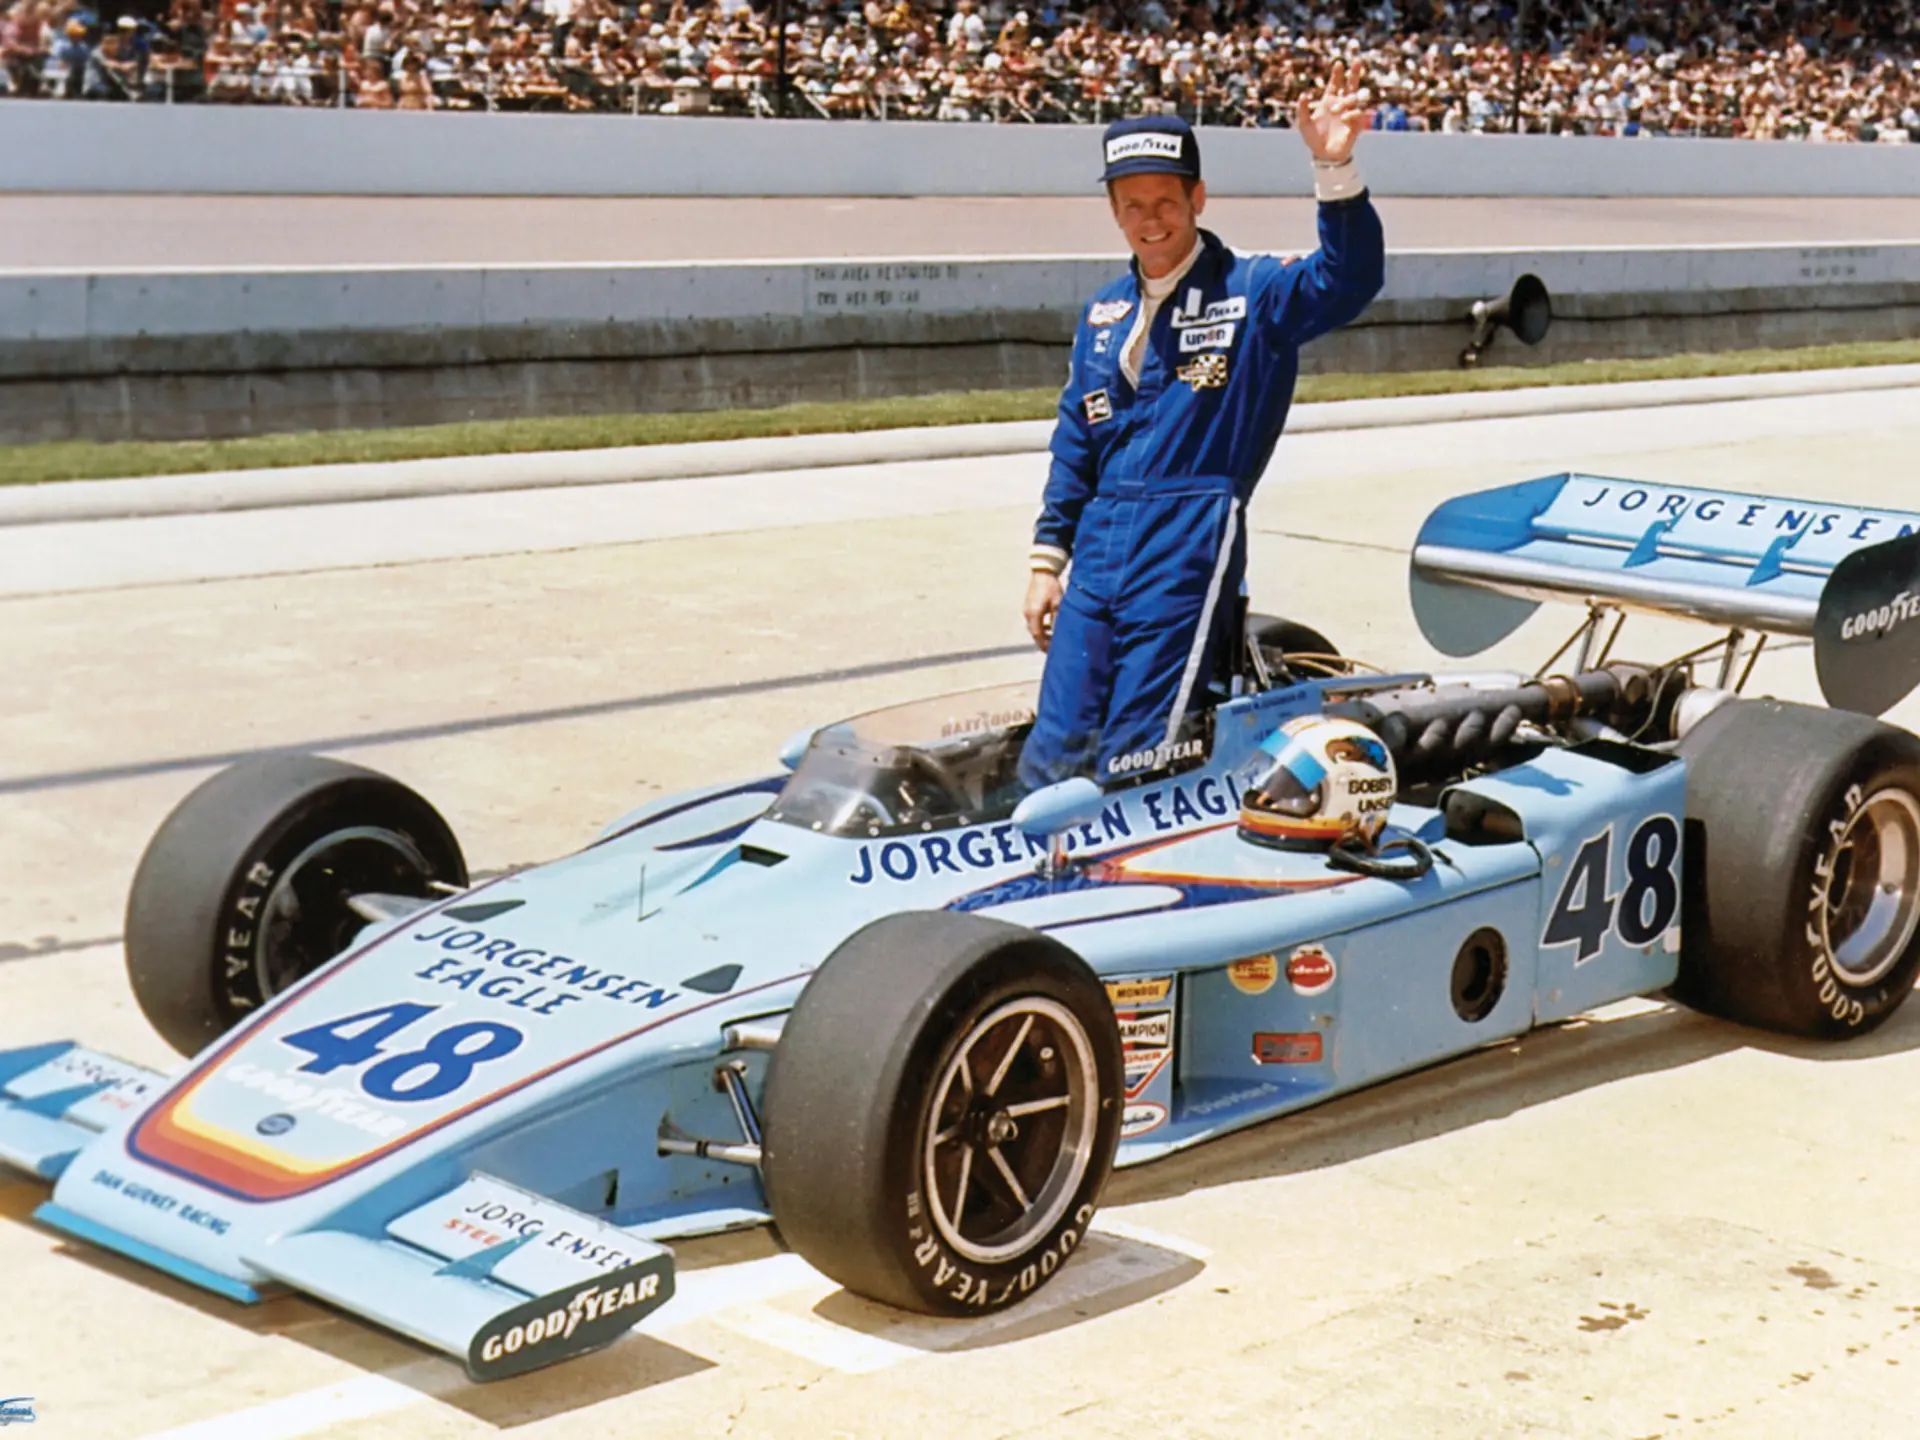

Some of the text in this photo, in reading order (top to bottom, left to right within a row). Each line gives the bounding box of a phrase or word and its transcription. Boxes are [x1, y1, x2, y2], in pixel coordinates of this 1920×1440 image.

[1112, 138, 1177, 156] GOODYEAR
[1841, 590, 1920, 640] GOODYE
[1108, 739, 1204, 774] GOODYEAR
[1143, 775, 1241, 831] EAGL
[1358, 798, 1391, 812] UNS
[1540, 813, 1681, 967] 48
[1806, 784, 1863, 1026] GOODYEAR
[225, 861, 274, 982] YEAR
[414, 926, 680, 1008] JORGENSEN
[415, 958, 582, 1014] EAGLE
[1117, 985, 1160, 998] MONROE
[280, 1002, 523, 1102] 48
[1120, 1023, 1166, 1037] AMPION
[91, 1169, 231, 1236] DAN GURNEY RACING
[444, 1218, 501, 1245] STEE
[915, 1203, 1093, 1306] GOODYEAR
[482, 1273, 660, 1361] GOODYEAR
